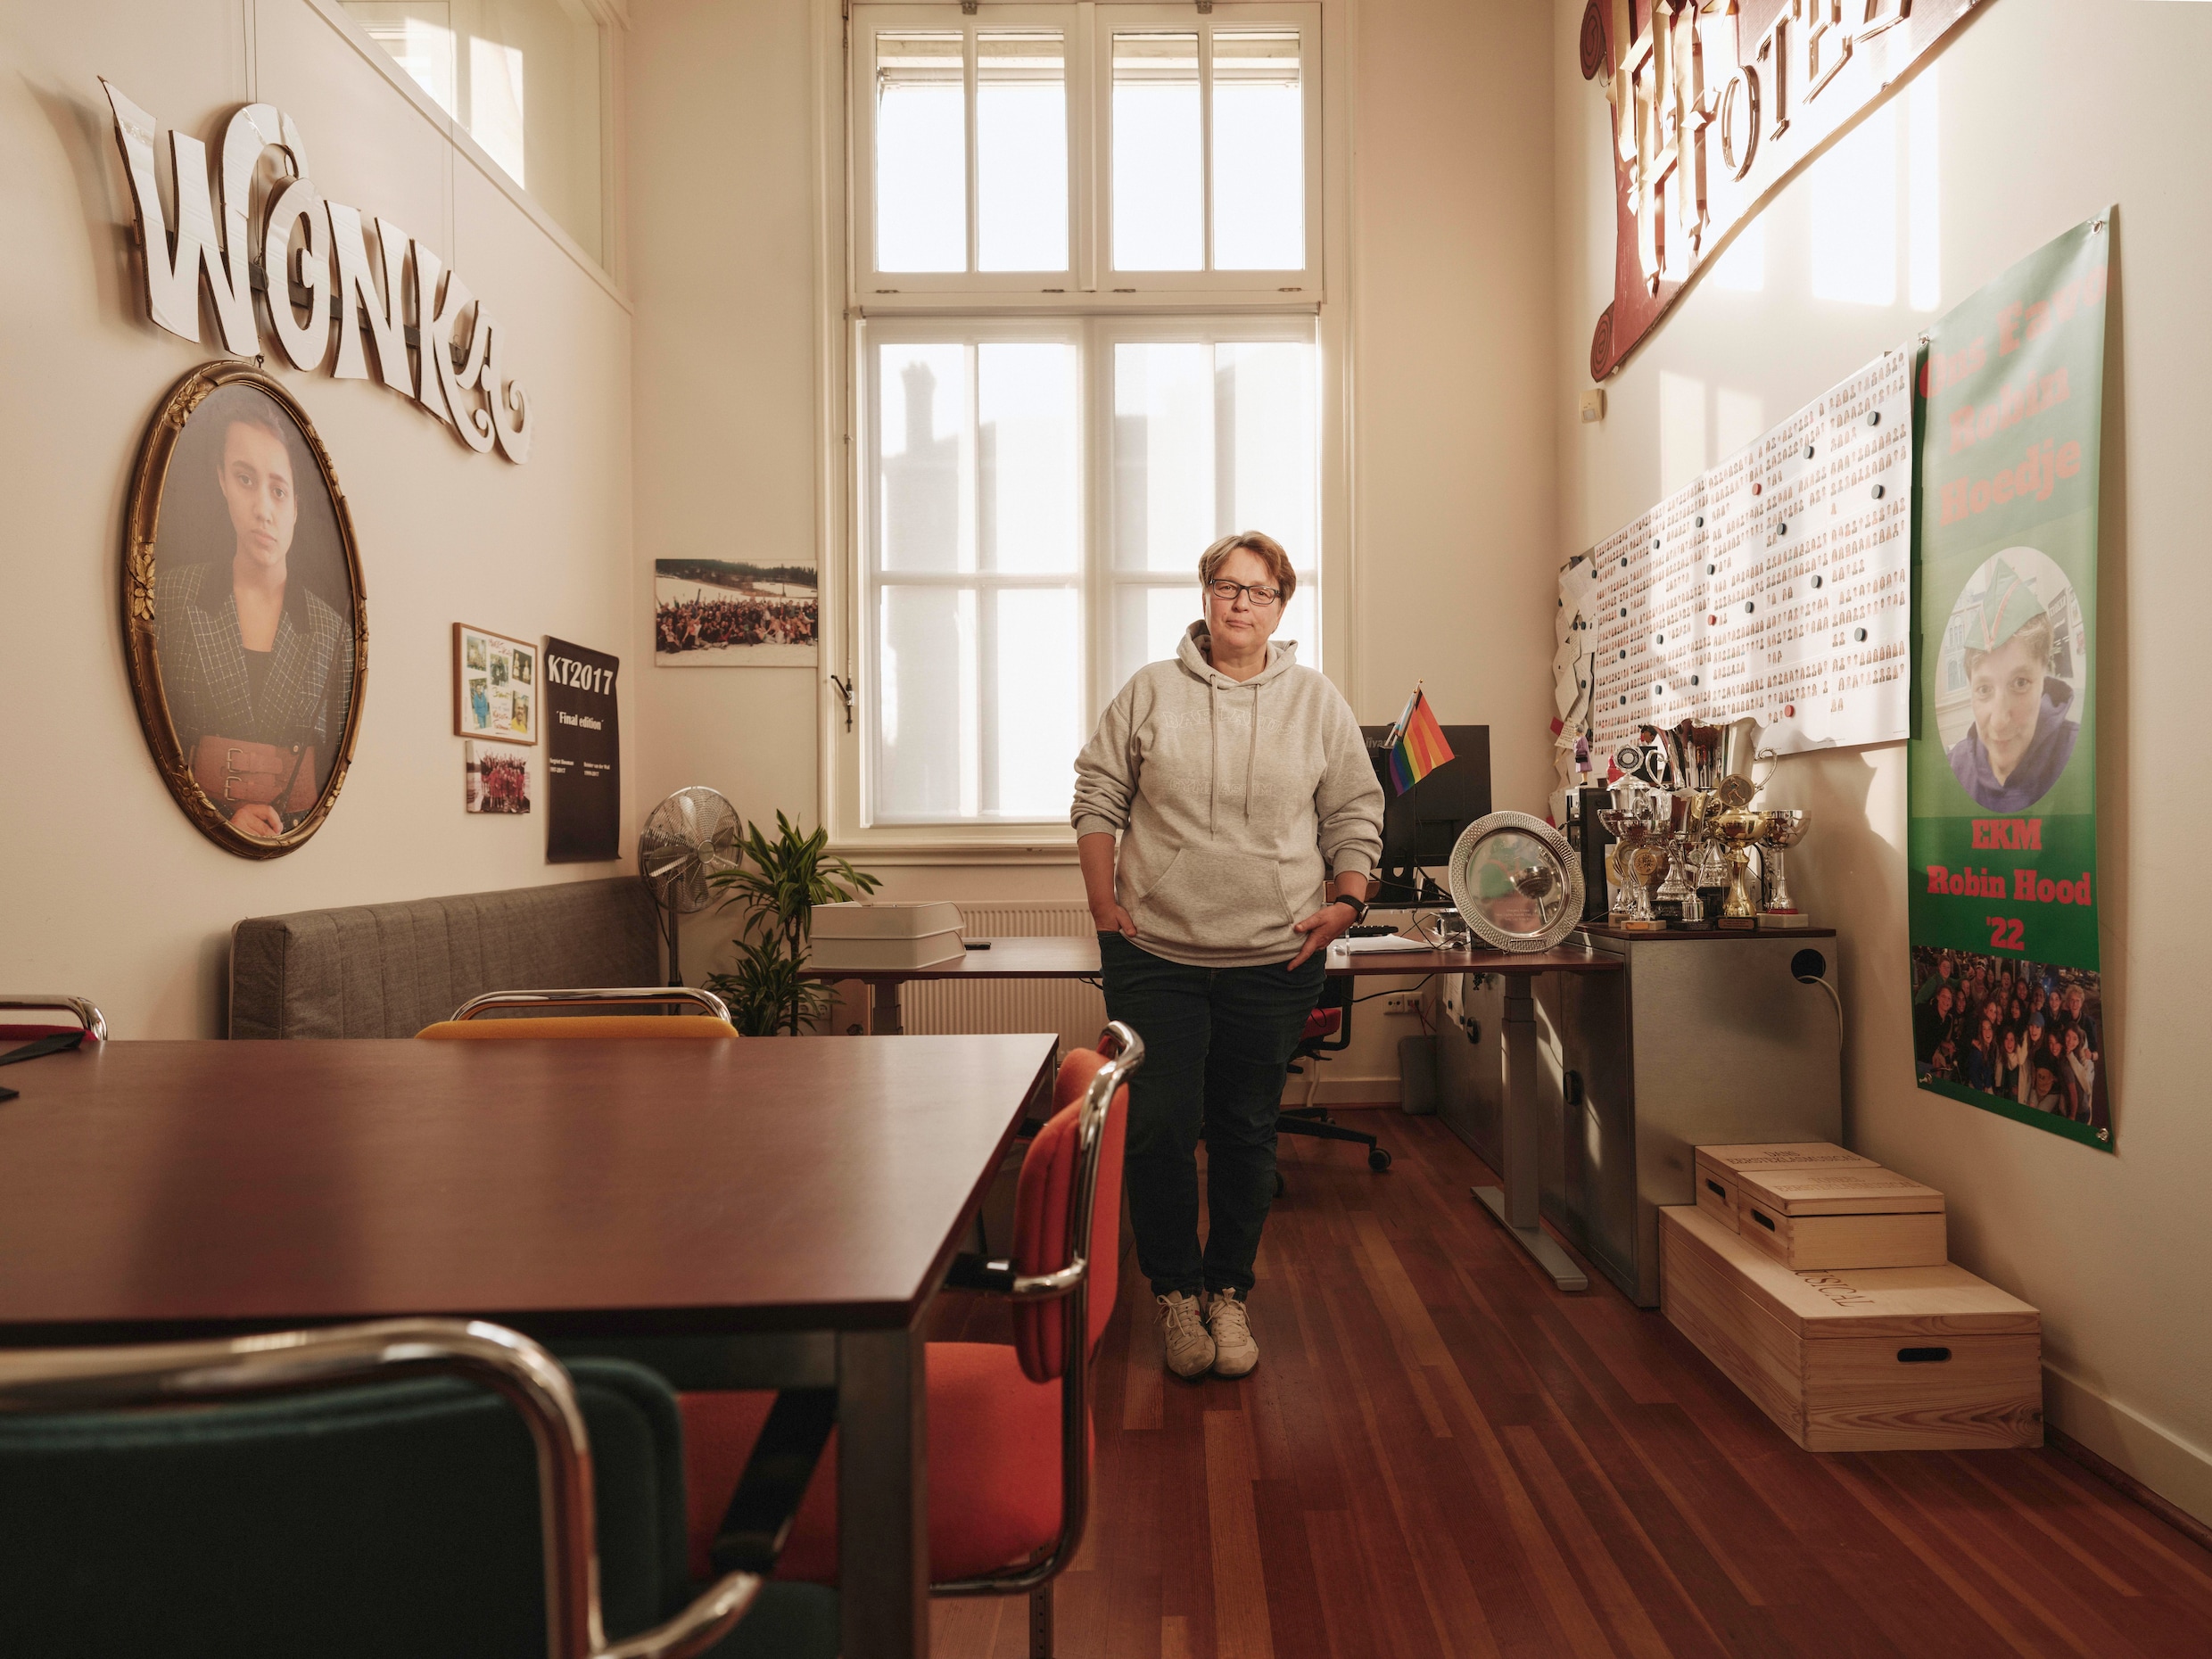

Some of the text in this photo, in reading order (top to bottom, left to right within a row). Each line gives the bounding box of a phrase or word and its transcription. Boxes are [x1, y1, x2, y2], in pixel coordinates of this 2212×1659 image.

[97, 76, 533, 464] WONKA
[1919, 335, 1986, 399] Ons
[1948, 366, 2071, 456] Robin
[1939, 437, 2082, 528] Hoedje
[548, 654, 614, 696] KT2017
[1971, 818, 2043, 850] EKM
[1927, 865, 2092, 906] Robin Hood
